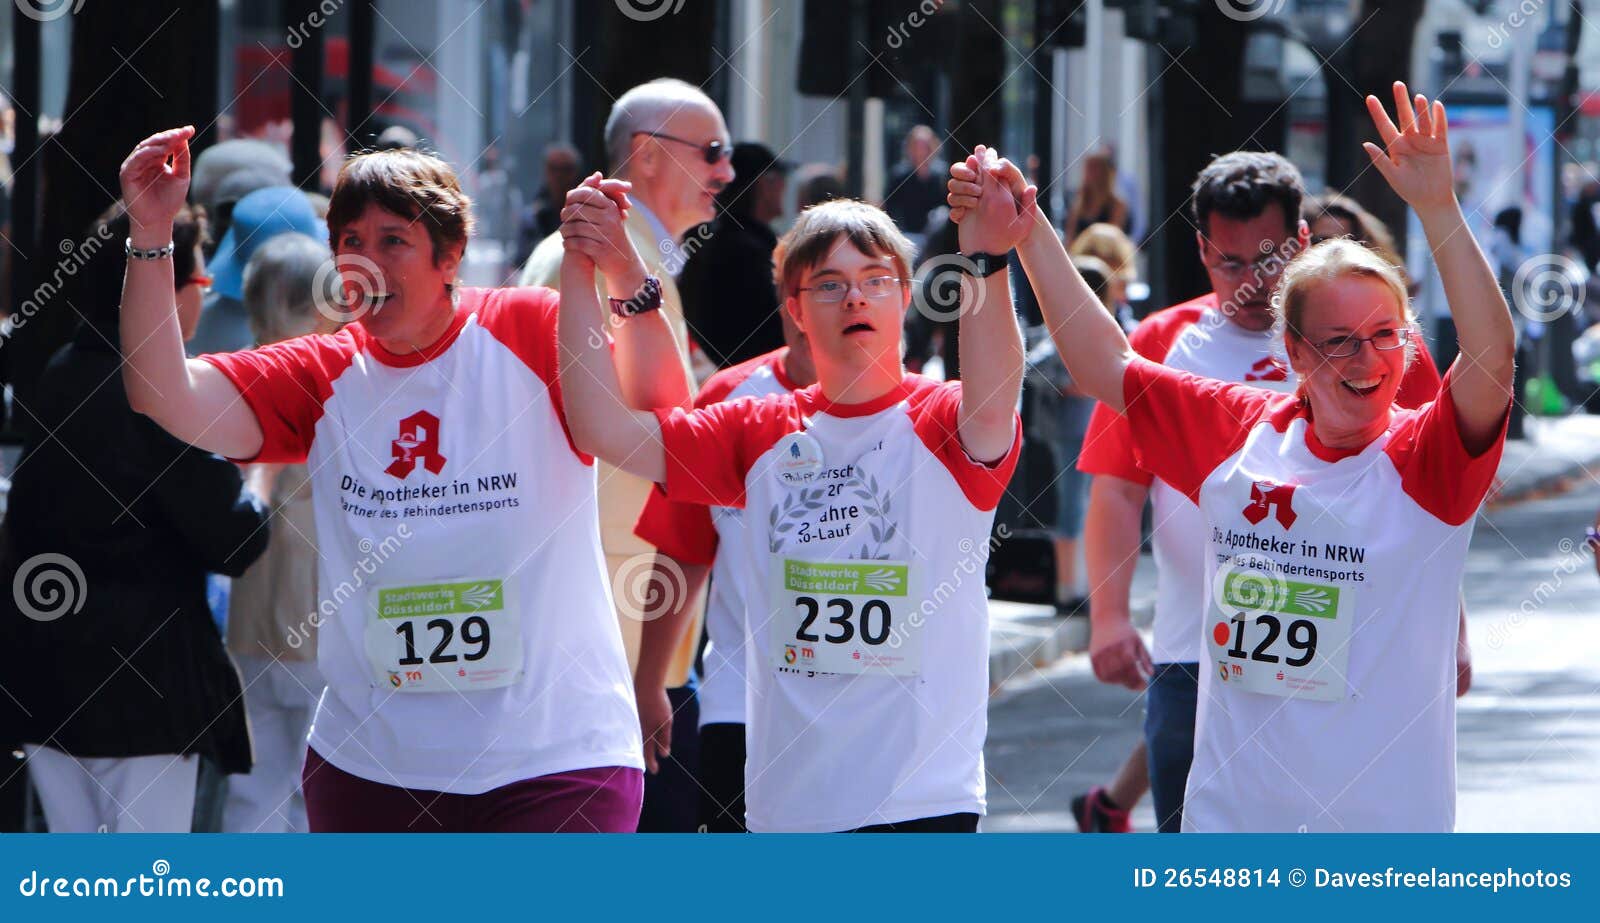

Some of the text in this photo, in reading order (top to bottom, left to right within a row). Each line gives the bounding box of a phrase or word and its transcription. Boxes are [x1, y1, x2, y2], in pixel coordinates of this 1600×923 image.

[341, 475, 366, 498] Die
[453, 480, 470, 495] in
[477, 472, 517, 492] NRW
[1225, 529, 1296, 555] Apotheker
[1301, 540, 1317, 557] in
[1325, 544, 1365, 563] NRW
[1249, 556, 1365, 582] Behindertensports
[396, 616, 490, 665] 129
[795, 597, 892, 646] 230
[1228, 612, 1318, 667] 129
